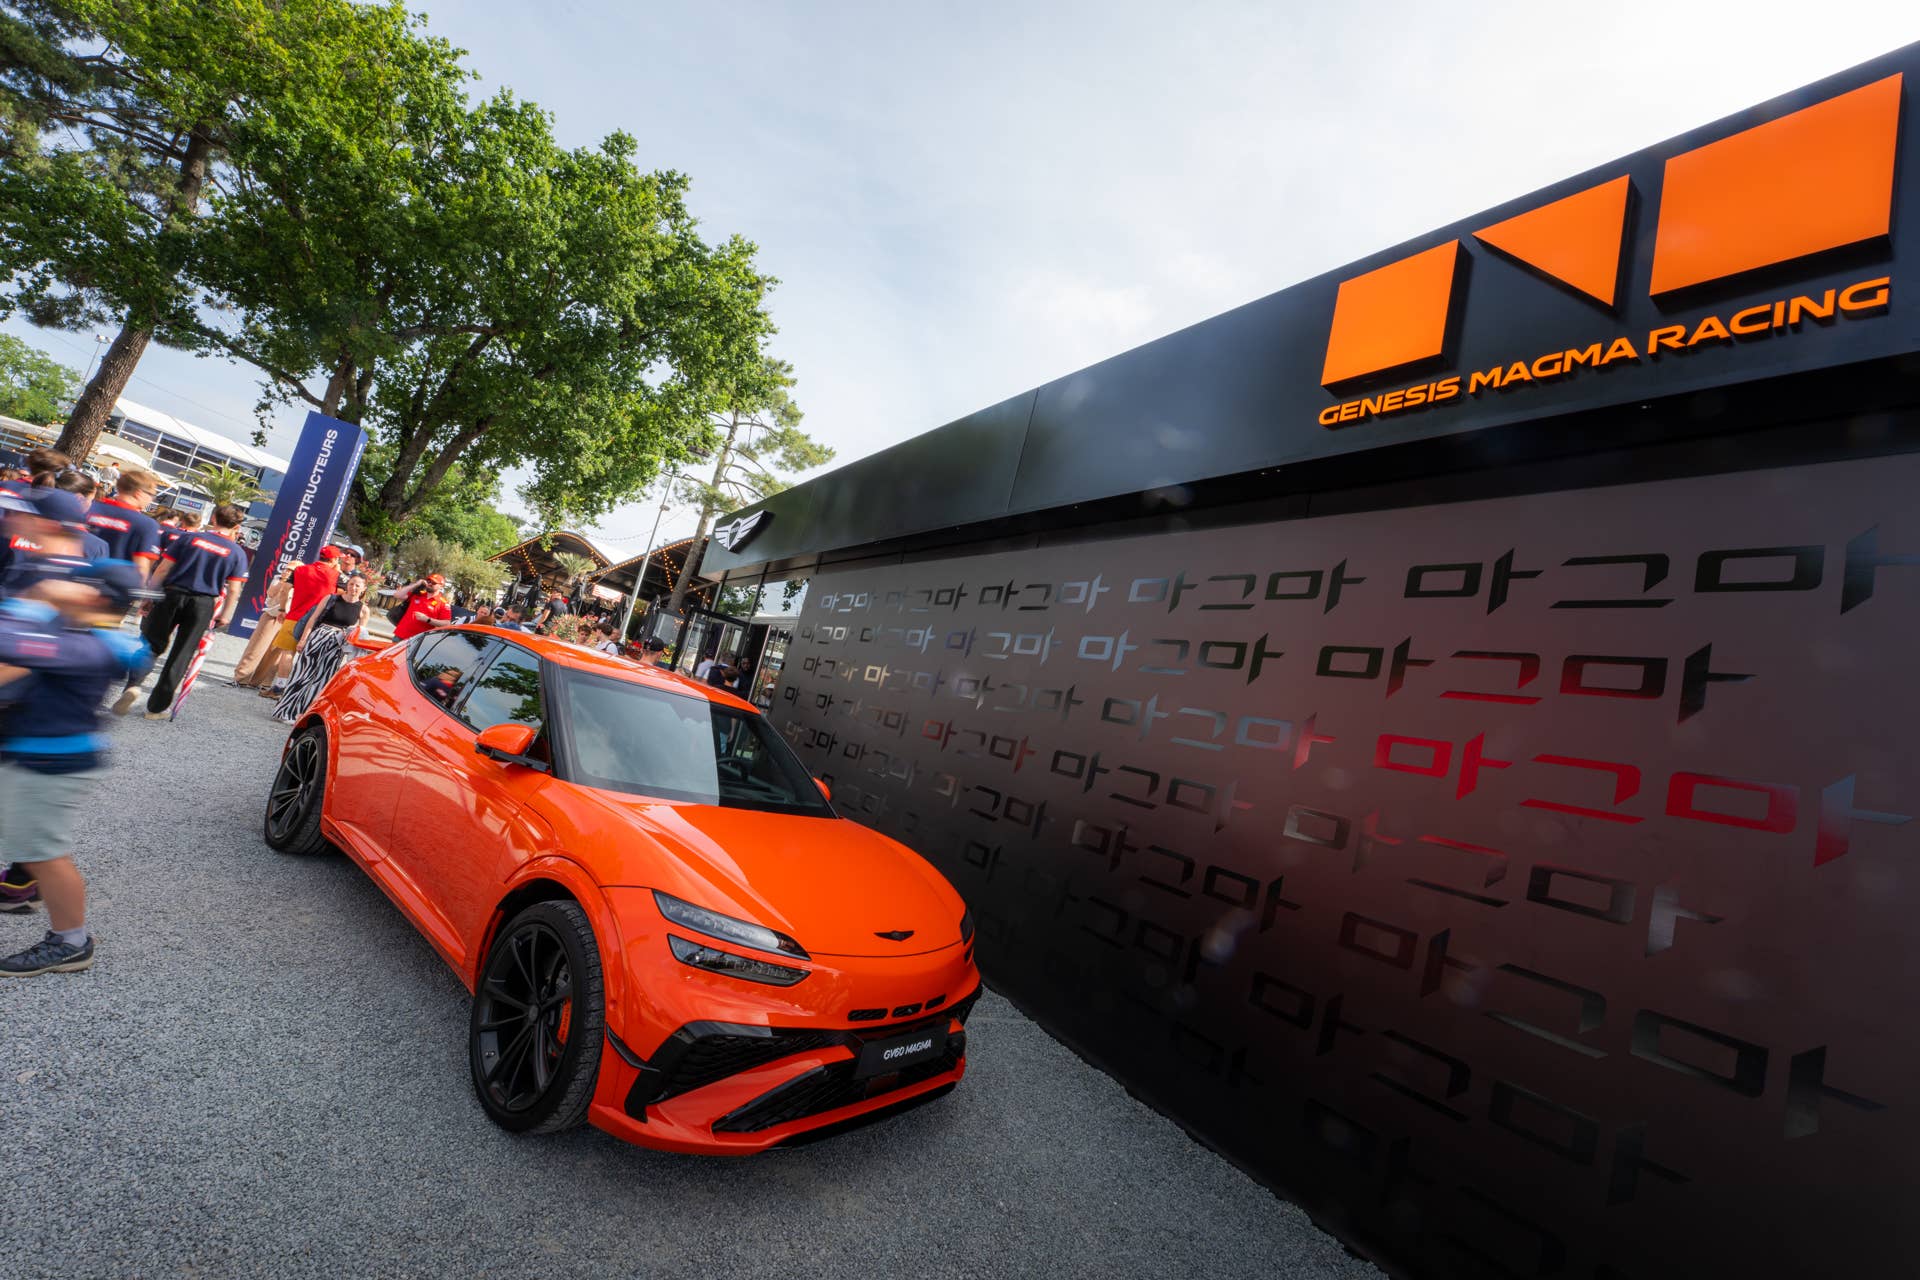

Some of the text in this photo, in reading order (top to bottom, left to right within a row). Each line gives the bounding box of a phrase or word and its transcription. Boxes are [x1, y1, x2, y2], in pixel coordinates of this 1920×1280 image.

[1318, 276, 1891, 426] GENESIS MAGMA RACING
[285, 429, 338, 553] CONSTRUCTEURS
[302, 517, 318, 548] VILLAGE
[1127, 557, 1368, 616] 마그마
[1076, 627, 1286, 687] 마그마
[1314, 634, 1759, 726] 마그마
[1100, 691, 1338, 770] 마그마
[1372, 730, 1914, 869] 마그마
[1050, 750, 1257, 835] 마그마
[1282, 803, 1727, 959] 마그마
[883, 1038, 932, 1061] GV60 MAGMA
[1337, 911, 1889, 1141] 마그마
